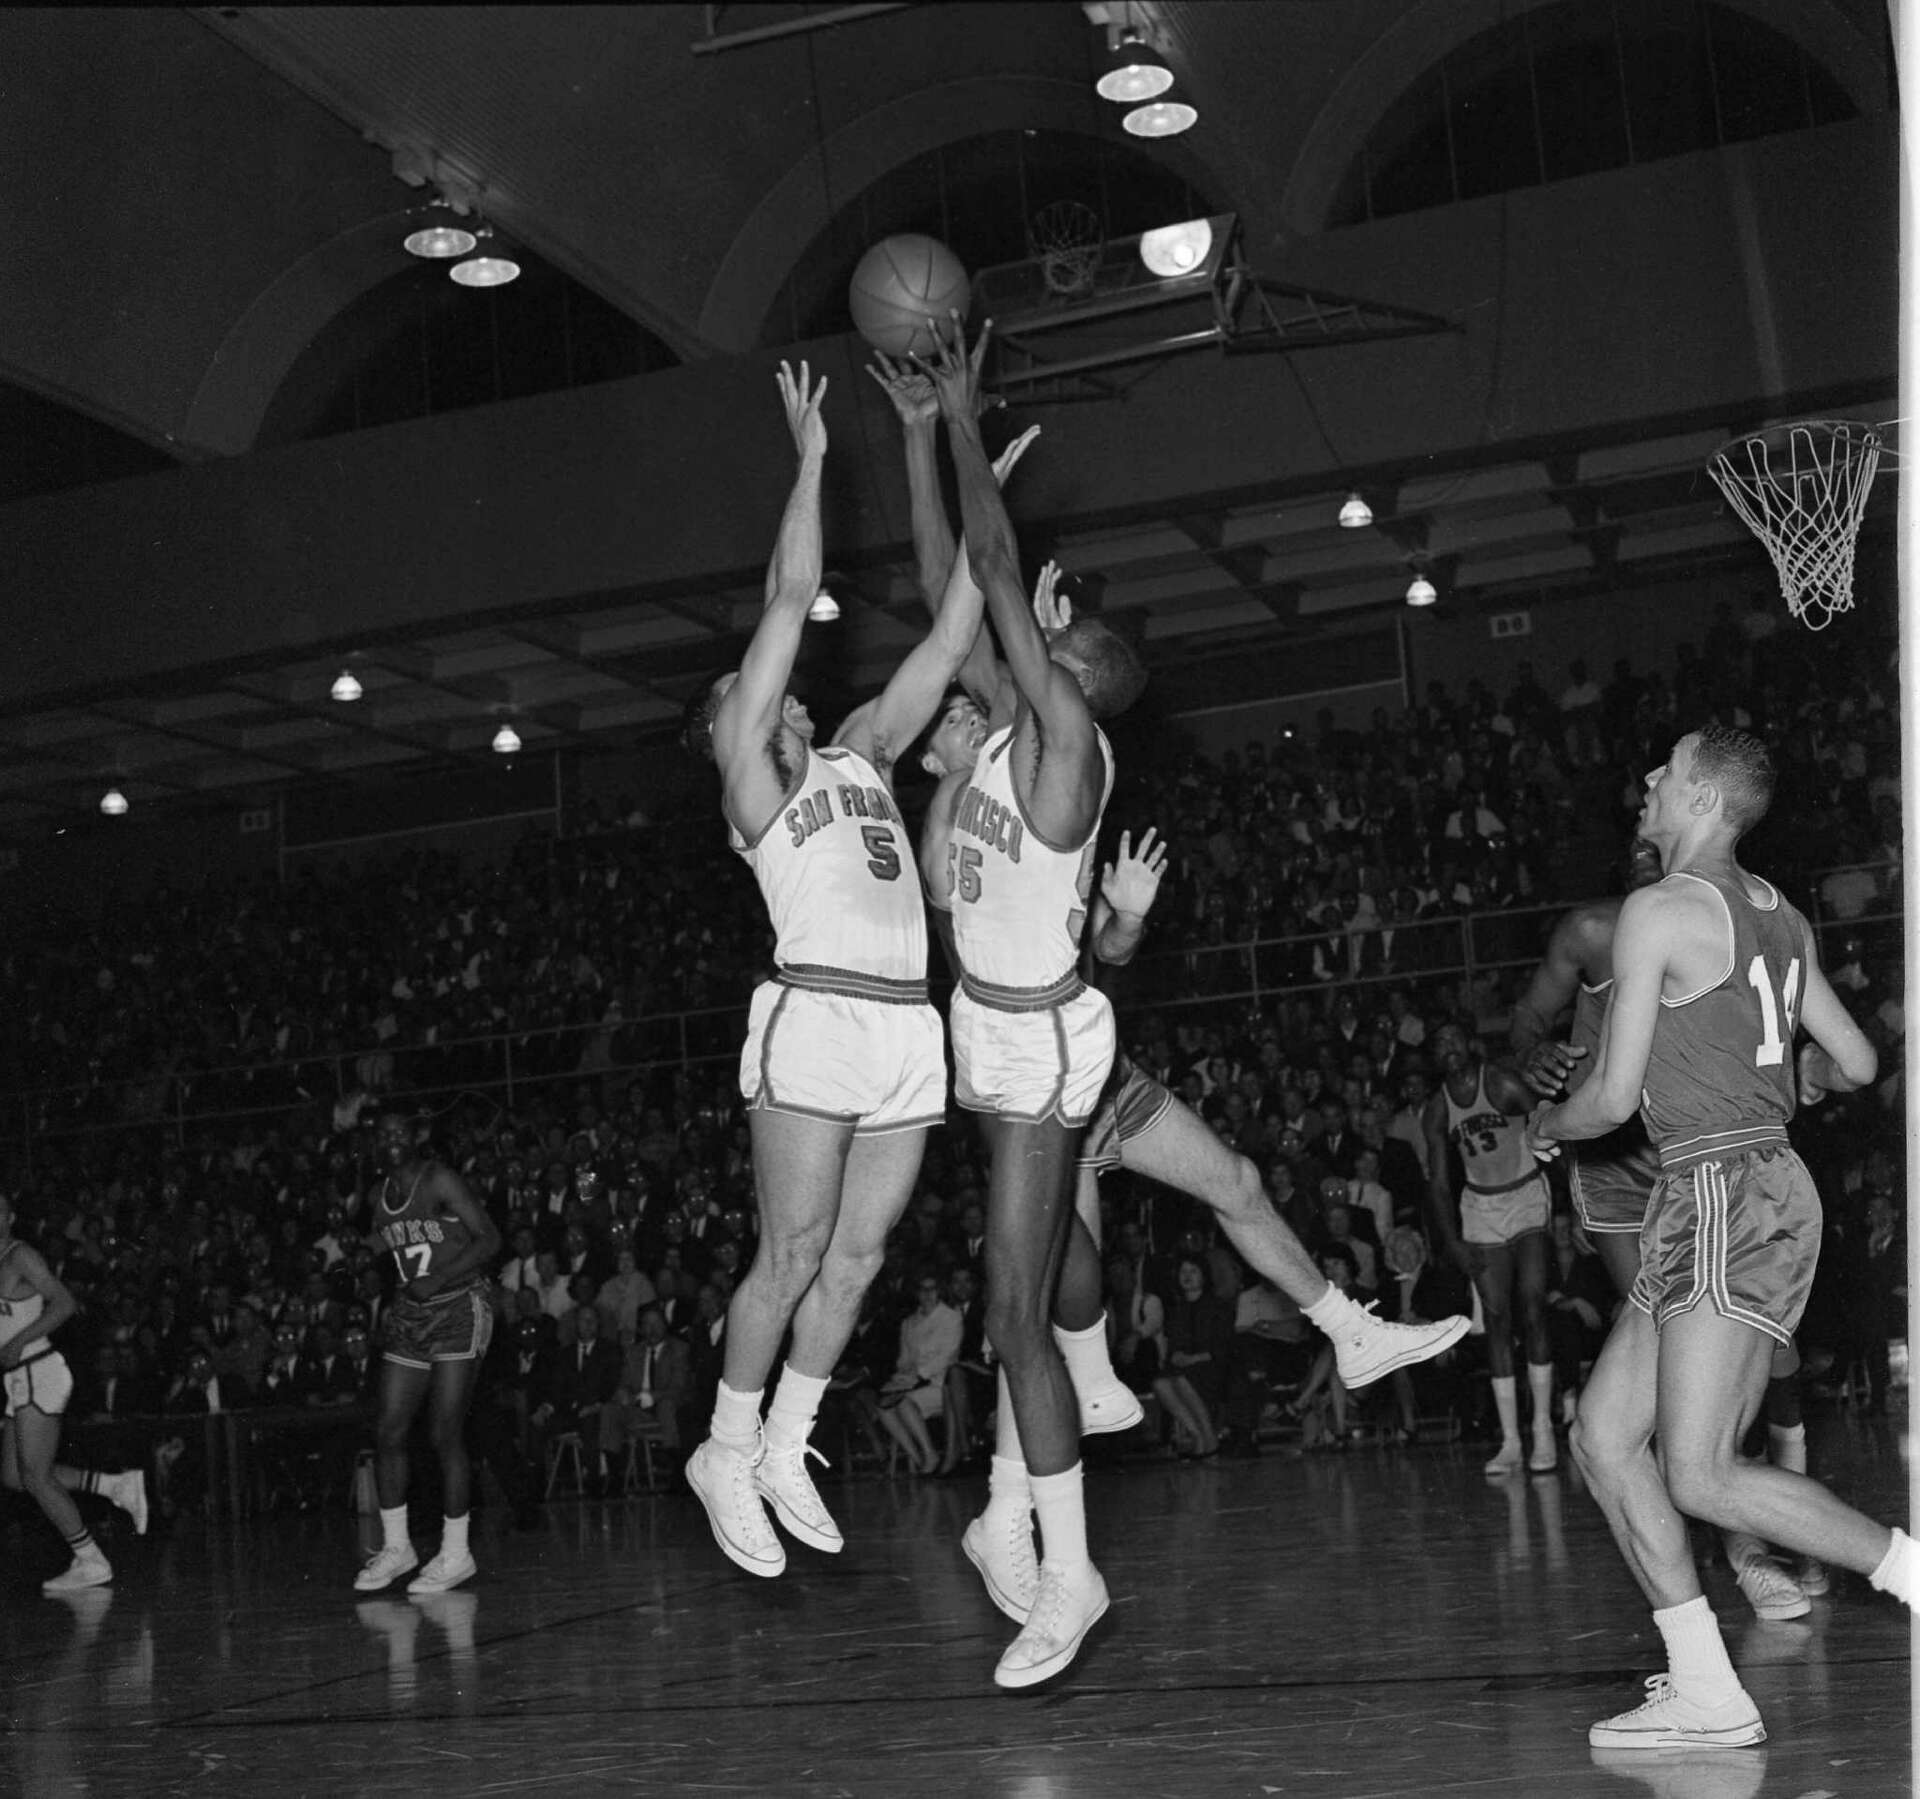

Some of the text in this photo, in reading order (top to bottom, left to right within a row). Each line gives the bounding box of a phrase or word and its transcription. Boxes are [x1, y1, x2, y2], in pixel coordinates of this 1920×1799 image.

[784, 789, 834, 848] SAN
[860, 824, 902, 882] 5
[1747, 954, 1800, 1068] 14
[392, 1242, 433, 1283] 17
